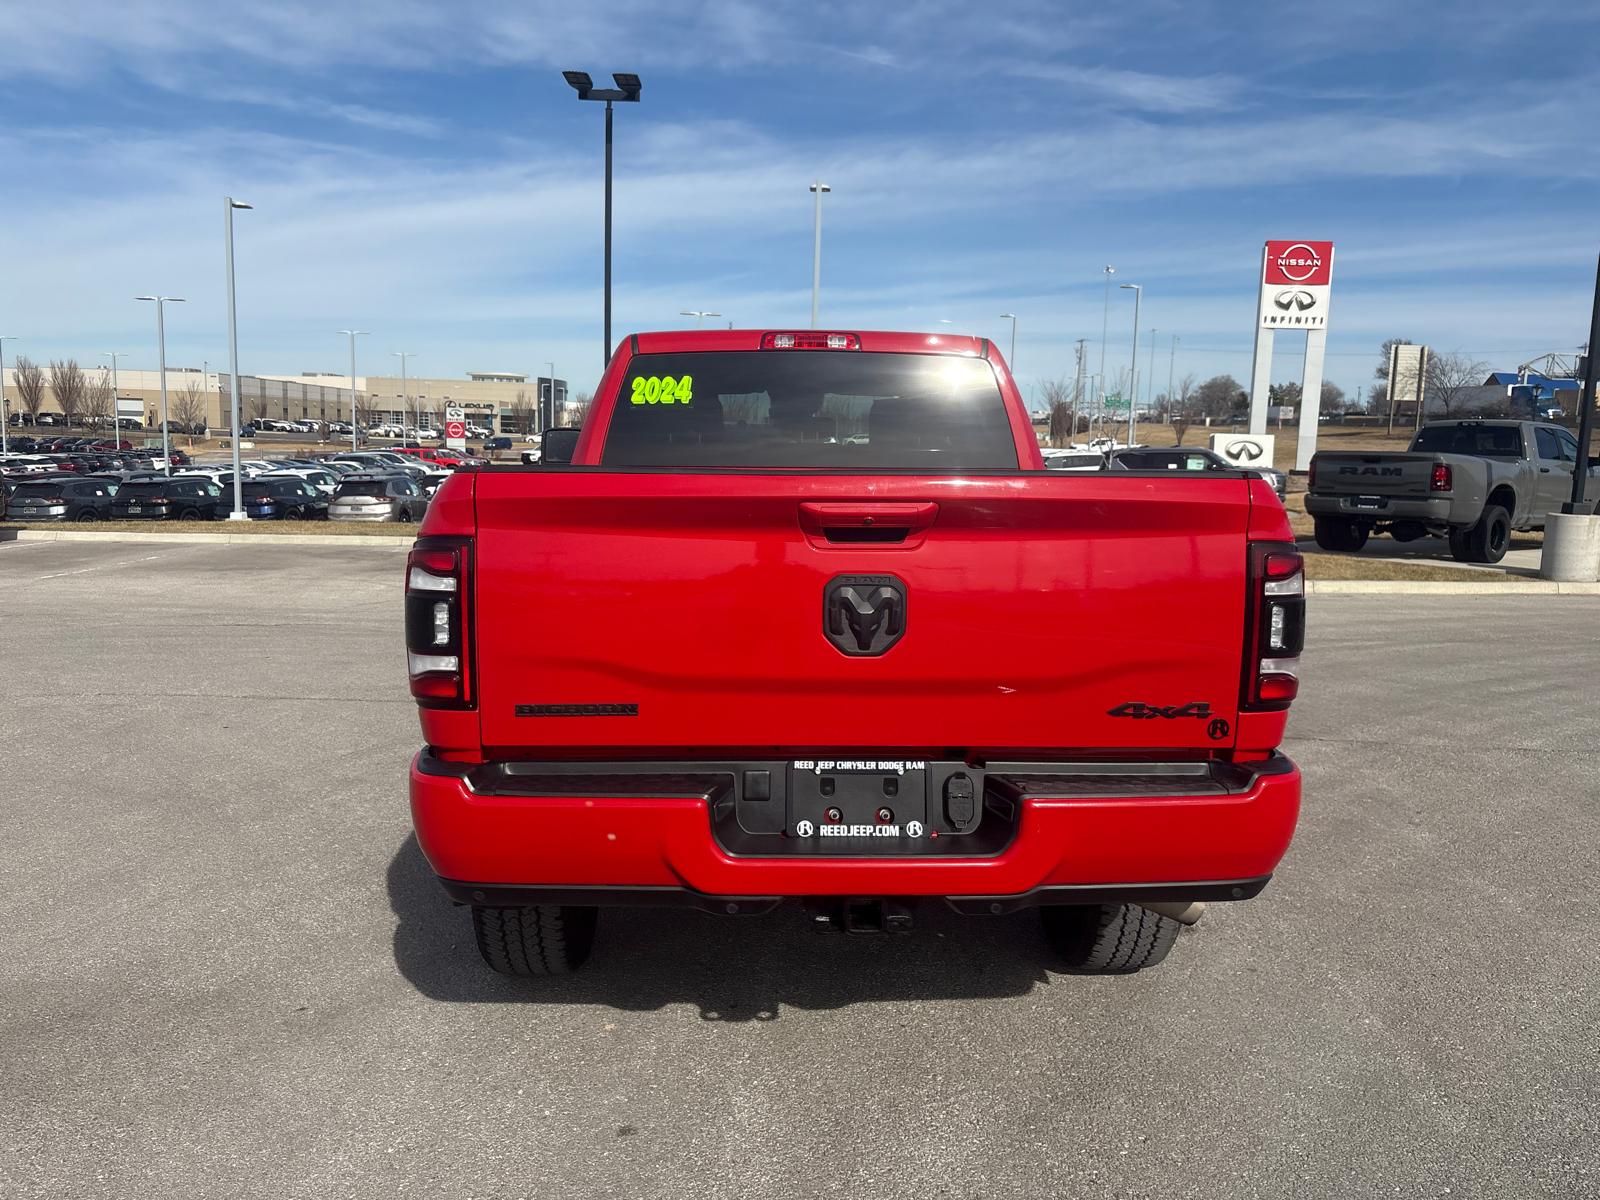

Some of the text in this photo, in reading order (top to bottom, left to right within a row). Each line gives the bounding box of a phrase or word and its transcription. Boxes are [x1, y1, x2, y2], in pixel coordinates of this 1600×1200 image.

[1277, 258, 1321, 266] NISSAN
[1263, 315, 1324, 325] INFINITI
[630, 375, 693, 404] 2024
[1339, 466, 1403, 476] RAM
[841, 576, 891, 584] RAM
[514, 703, 638, 717] BIGHORN
[794, 761, 925, 770] REED JEEP CHRYSLER DODGE RAM
[820, 825, 900, 836] REEDJEEP.COM
